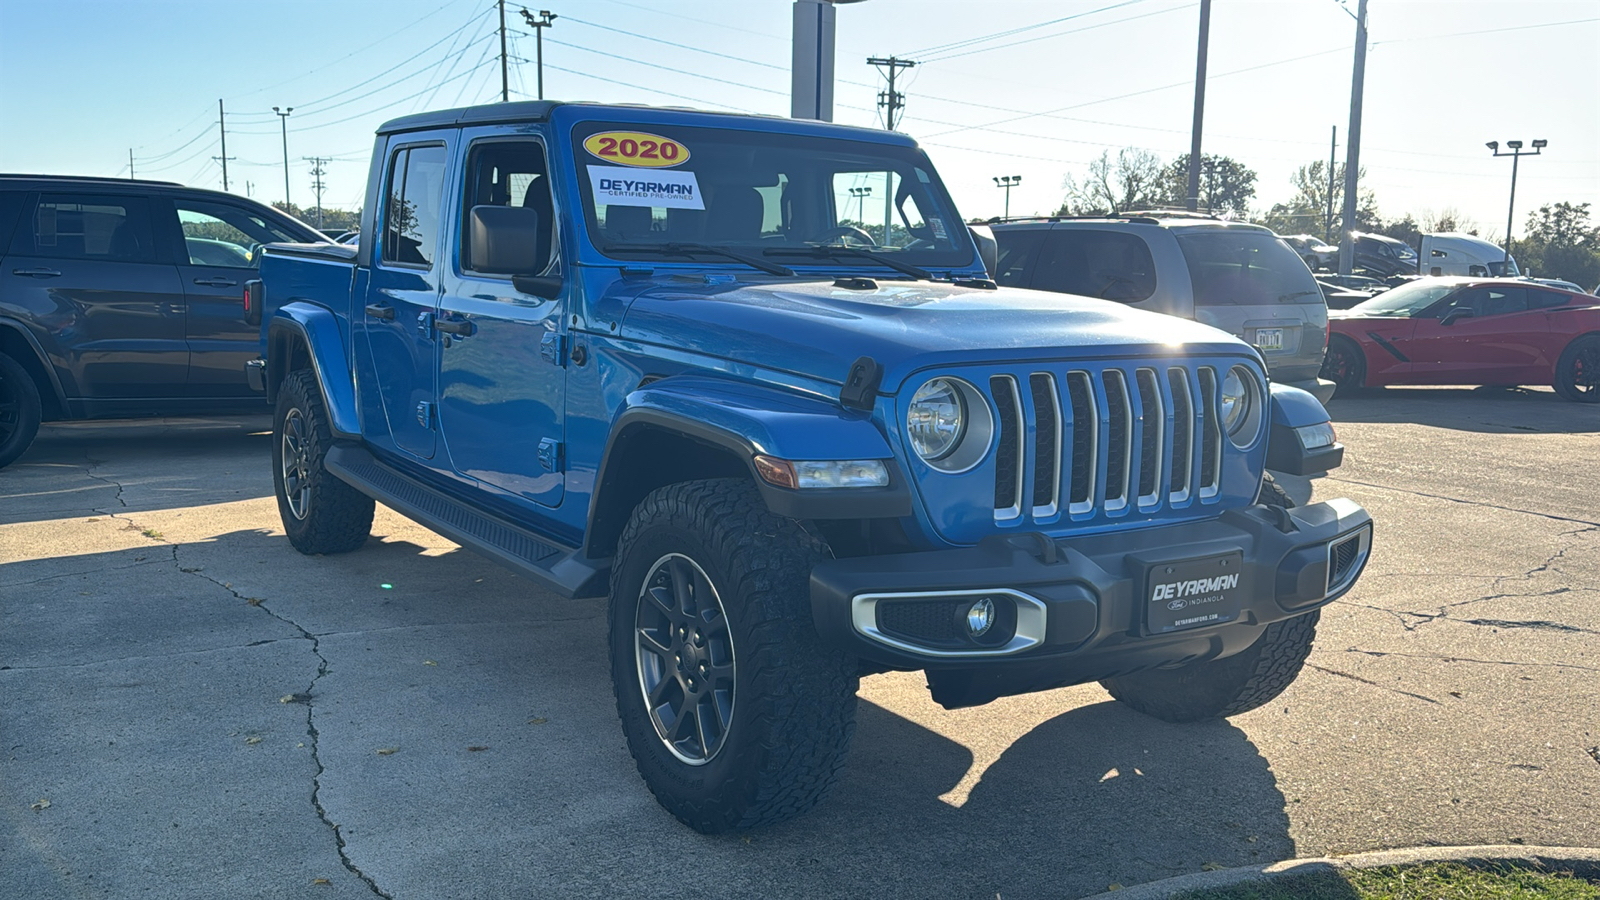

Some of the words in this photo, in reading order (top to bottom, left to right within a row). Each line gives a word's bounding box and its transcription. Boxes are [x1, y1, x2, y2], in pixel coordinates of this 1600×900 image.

[598, 137, 679, 160] 2020
[600, 178, 693, 195] DEYARMAN
[608, 190, 648, 198] CERTIFIED
[650, 192, 694, 201] PRE-OWNED
[1152, 573, 1239, 601] DEYARMAN
[1189, 595, 1225, 606] INDIANOLA
[1175, 614, 1218, 626] DEYARMANFORD.COM
